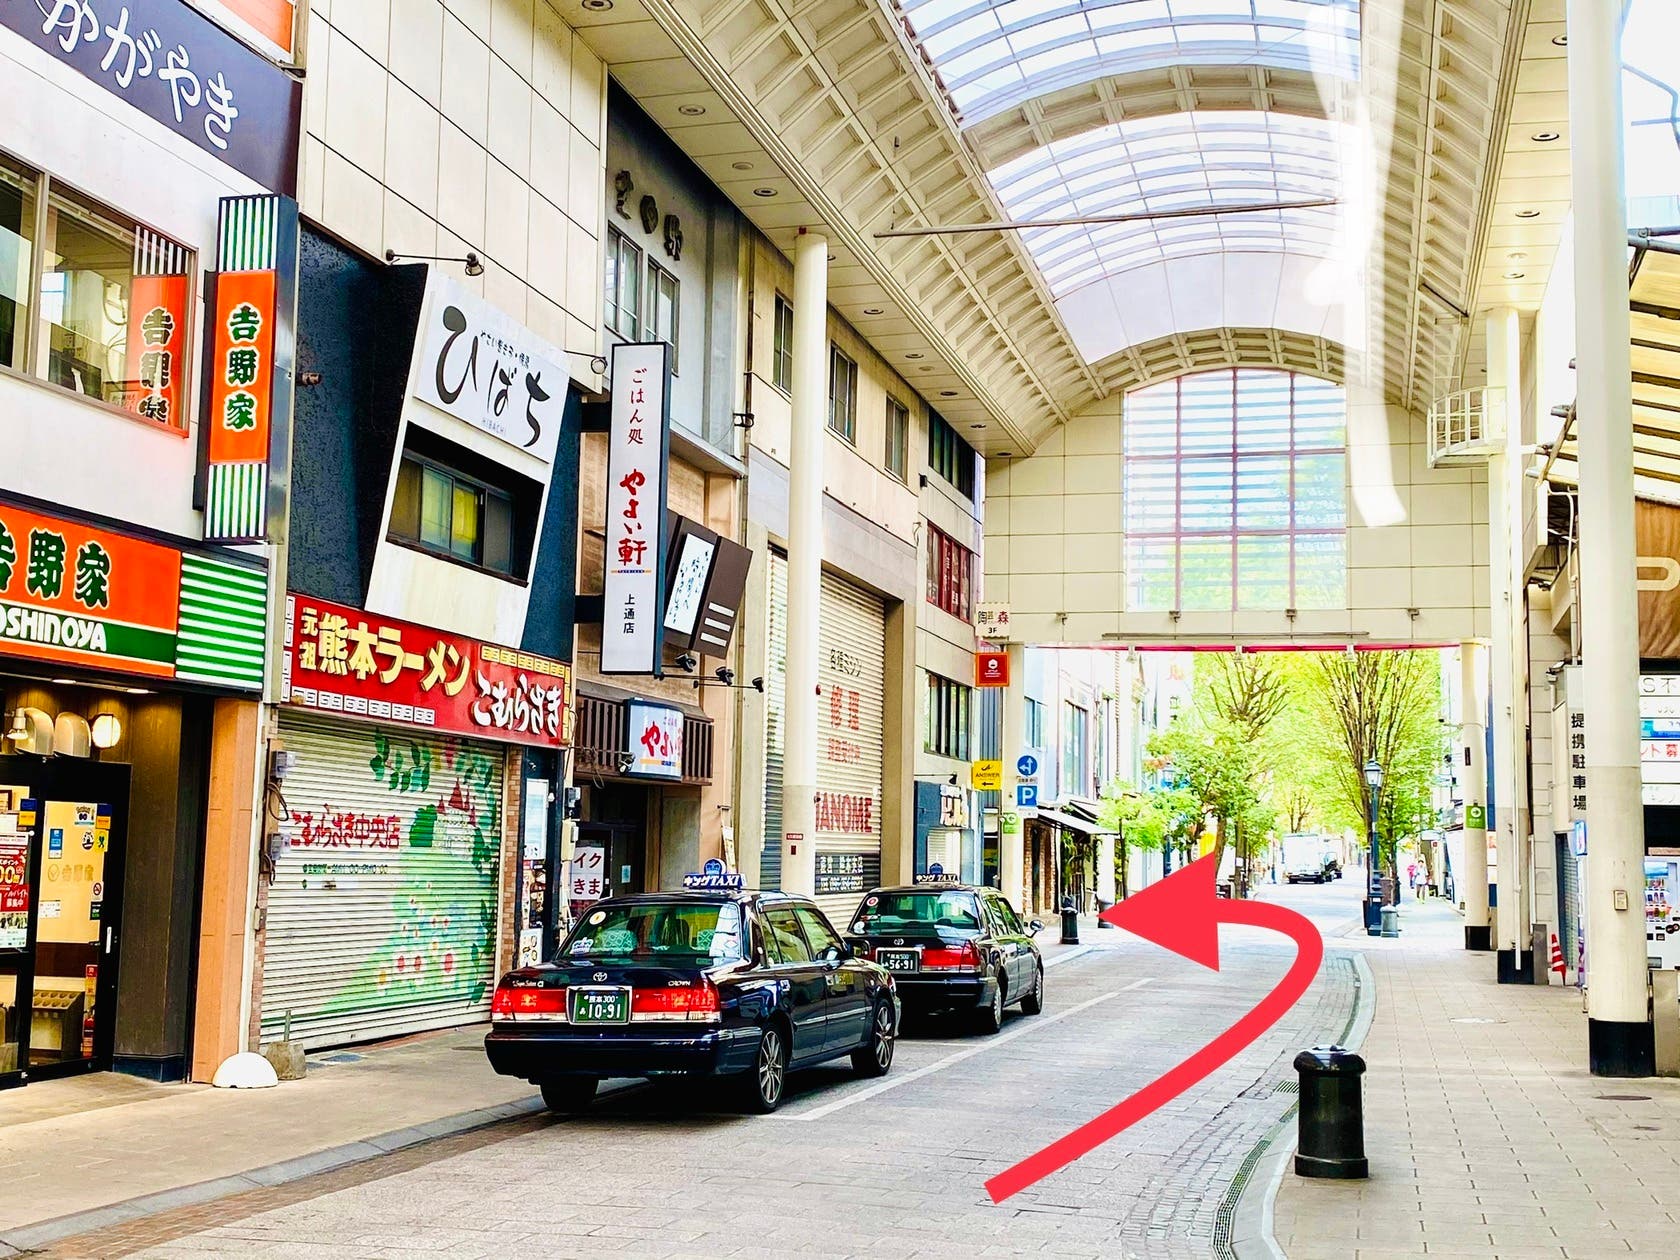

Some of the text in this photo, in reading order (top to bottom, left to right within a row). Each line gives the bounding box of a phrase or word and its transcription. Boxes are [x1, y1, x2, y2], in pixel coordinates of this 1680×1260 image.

[227, 303, 262, 431] 吉野家
[435, 305, 551, 448] ひばち
[628, 367, 648, 446] ごはん処
[617, 467, 648, 567] やよい軒
[299, 606, 319, 671] 元祖
[623, 593, 636, 635] 上通店
[988, 626, 998, 634] 3F
[318, 610, 471, 697] 熊本ラーメン
[471, 669, 563, 738] こむらさき
[1021, 787, 1034, 804] P
[1571, 713, 1587, 811] 提携駐車場
[290, 803, 401, 848] こむらさき中央店
[573, 852, 602, 868] イク
[573, 878, 602, 894] きま
